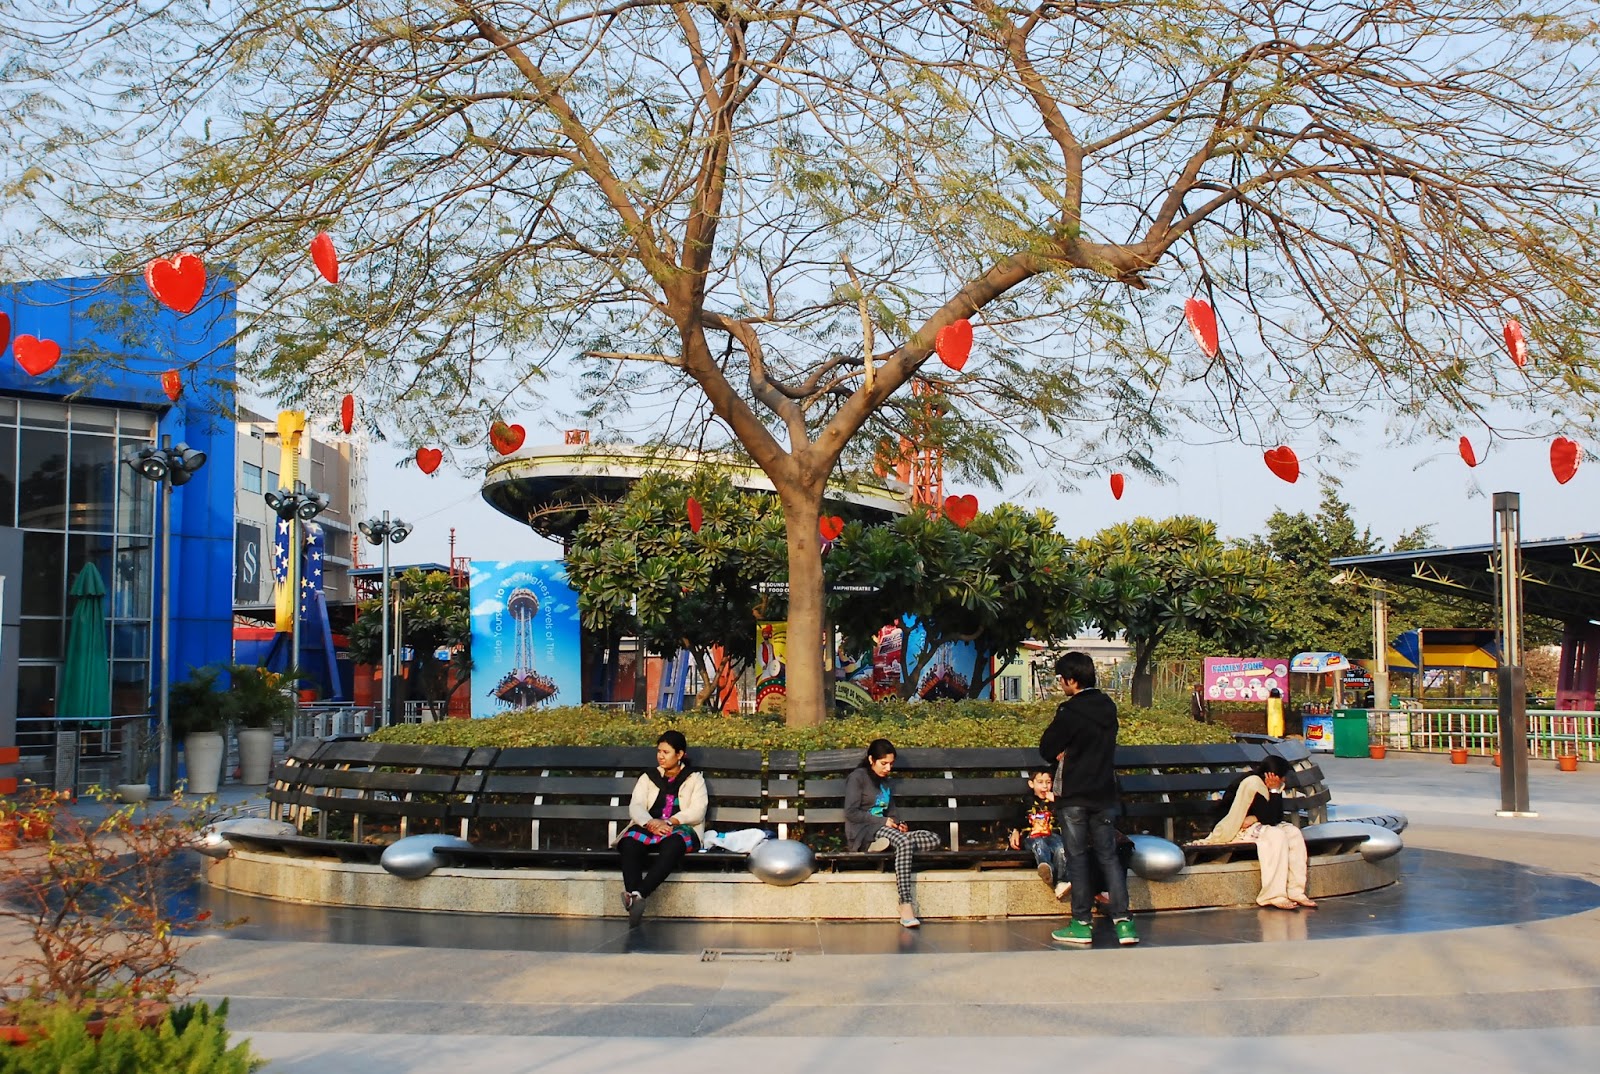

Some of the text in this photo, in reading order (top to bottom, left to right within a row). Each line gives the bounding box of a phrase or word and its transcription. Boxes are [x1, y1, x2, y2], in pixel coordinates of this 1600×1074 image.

[495, 588, 505, 598] to
[523, 572, 553, 599] Highest
[494, 604, 503, 637] Yourse
[544, 601, 554, 630] Levels
[545, 631, 554, 640] of
[1212, 661, 1264, 673] FAMILY ZONE
